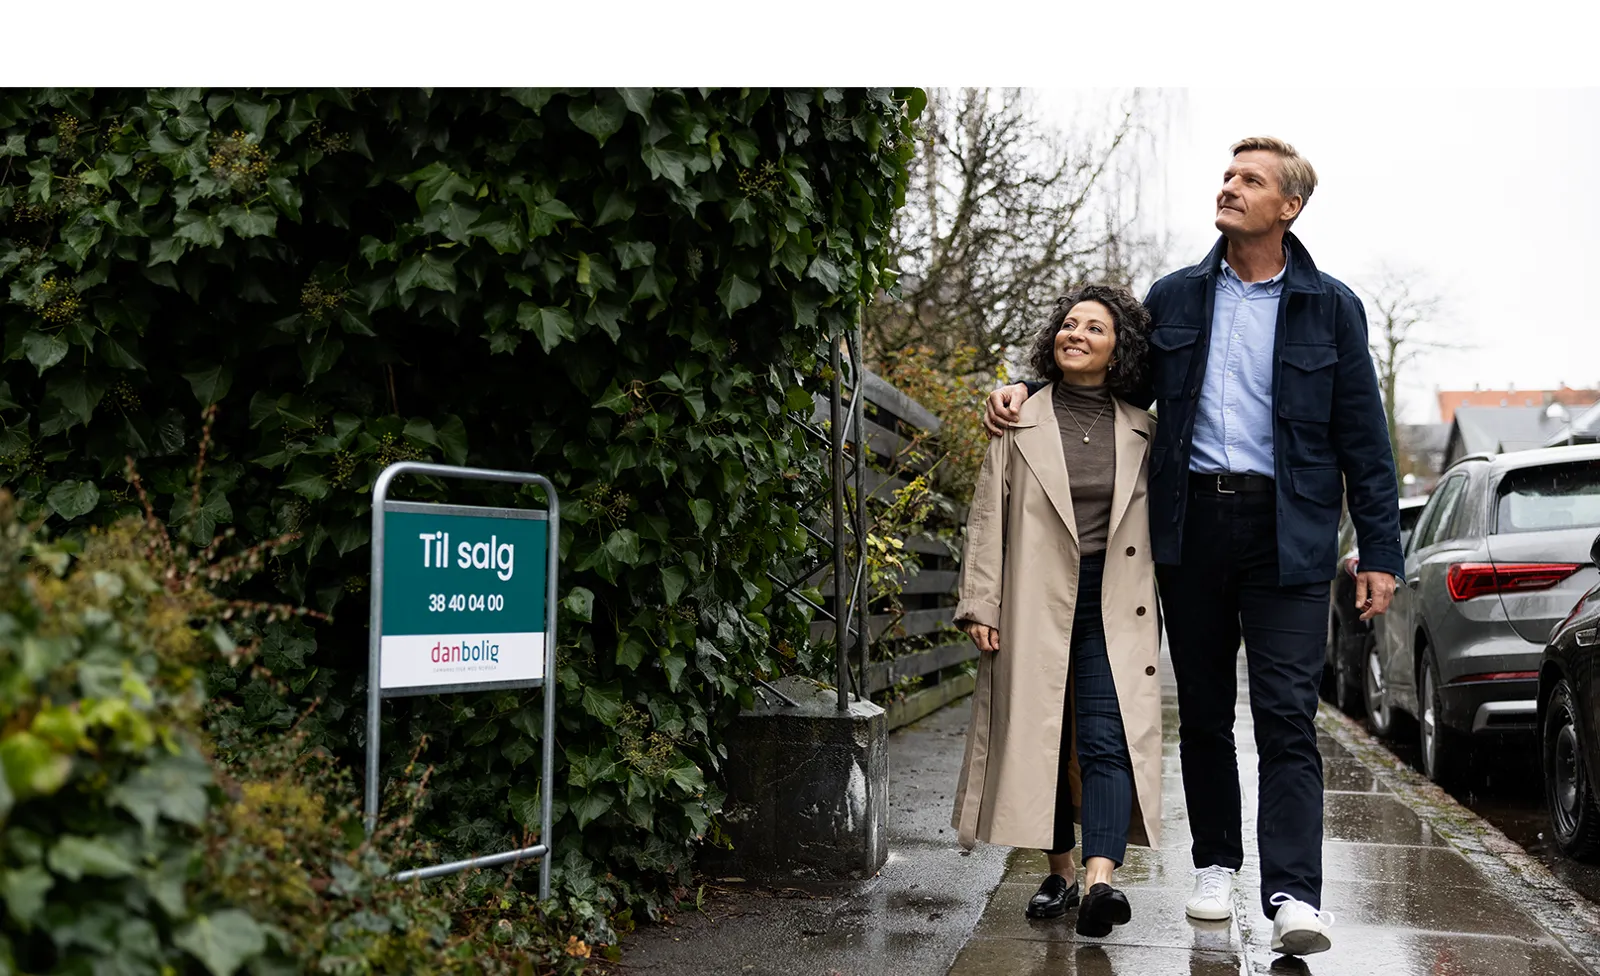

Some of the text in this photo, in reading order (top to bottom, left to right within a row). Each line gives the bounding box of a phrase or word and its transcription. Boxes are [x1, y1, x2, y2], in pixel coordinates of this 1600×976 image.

[419, 530, 514, 582] Til salg
[428, 593, 504, 612] 38 40 04 00
[431, 640, 500, 664] danbolig
